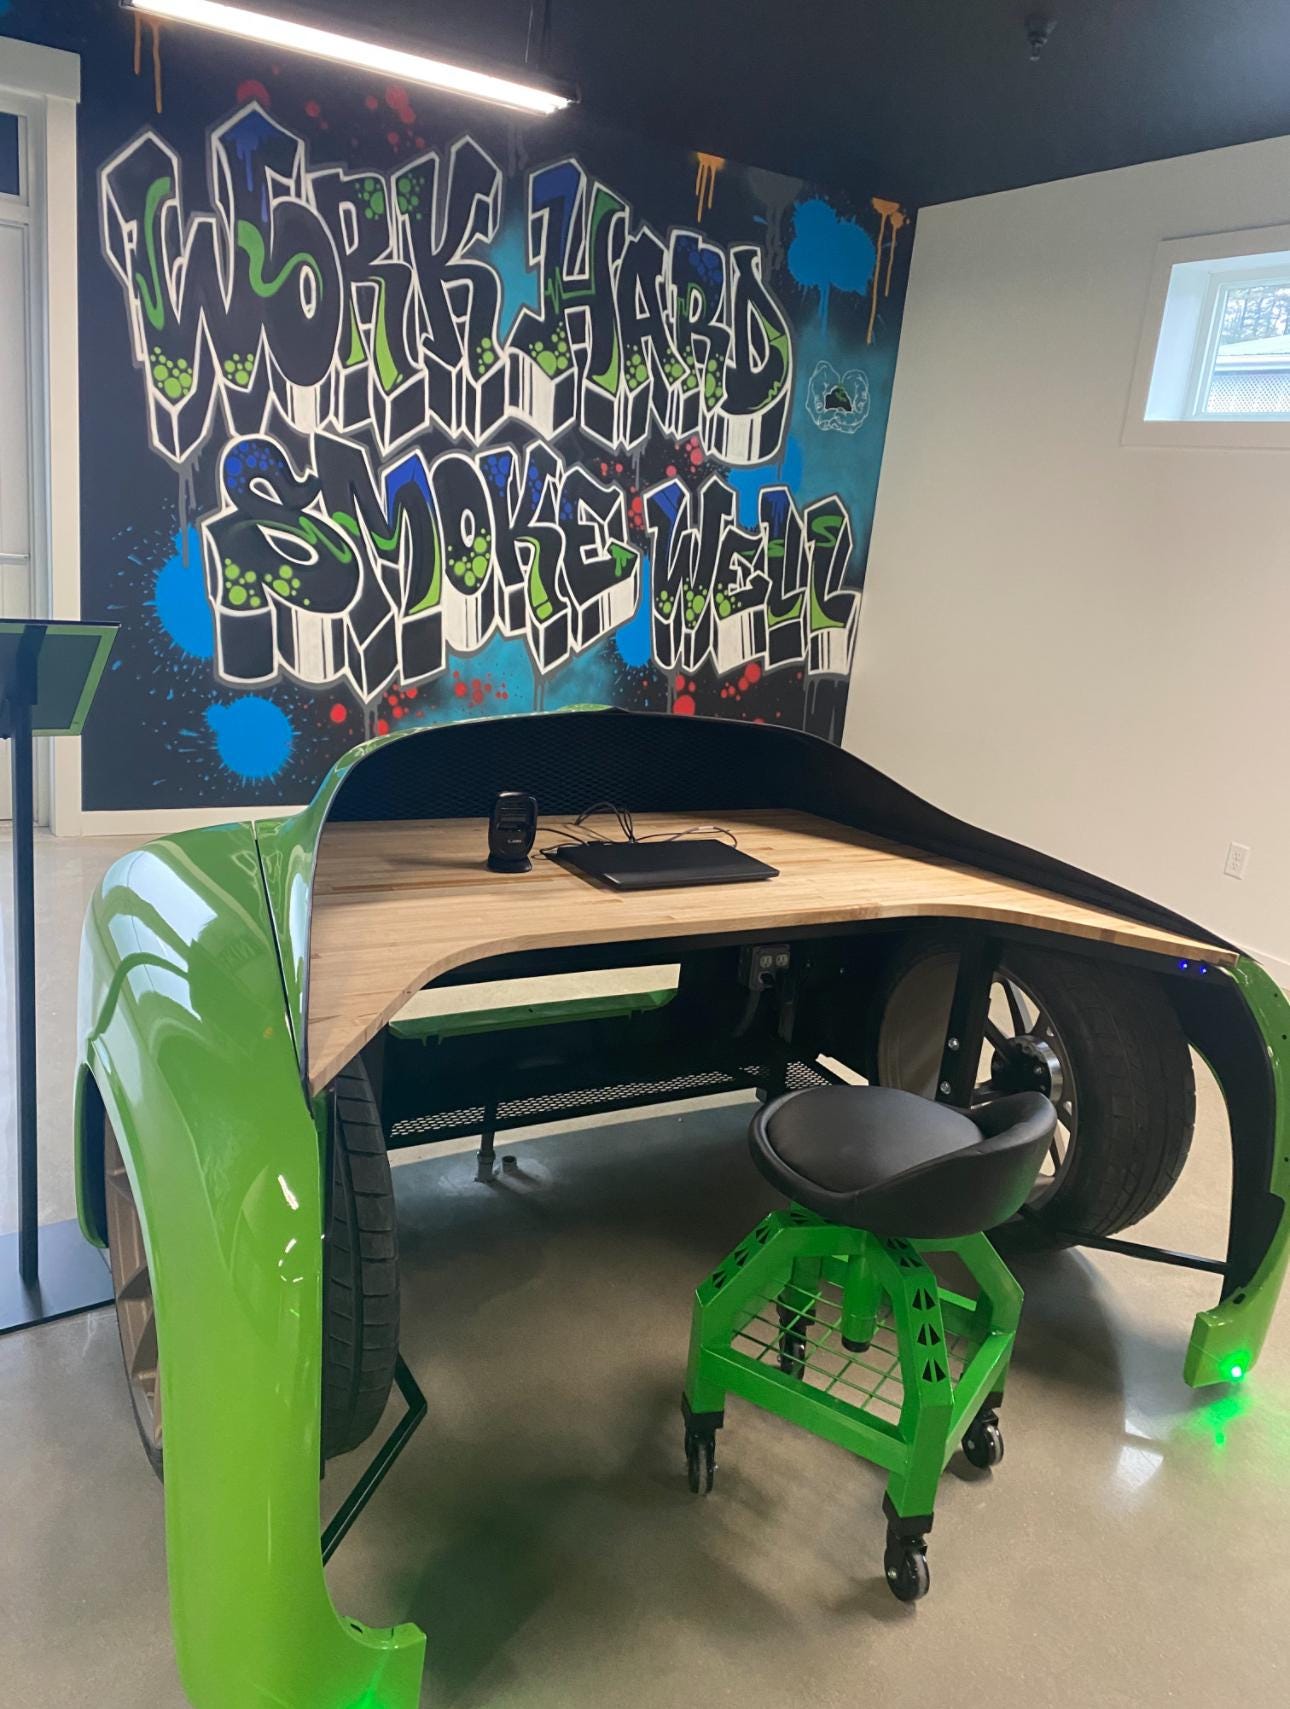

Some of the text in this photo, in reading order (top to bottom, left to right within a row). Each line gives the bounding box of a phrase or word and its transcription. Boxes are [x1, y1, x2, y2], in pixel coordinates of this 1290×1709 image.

[98, 100, 794, 466] WORK HARD
[201, 431, 862, 702] SMOKE WELL
